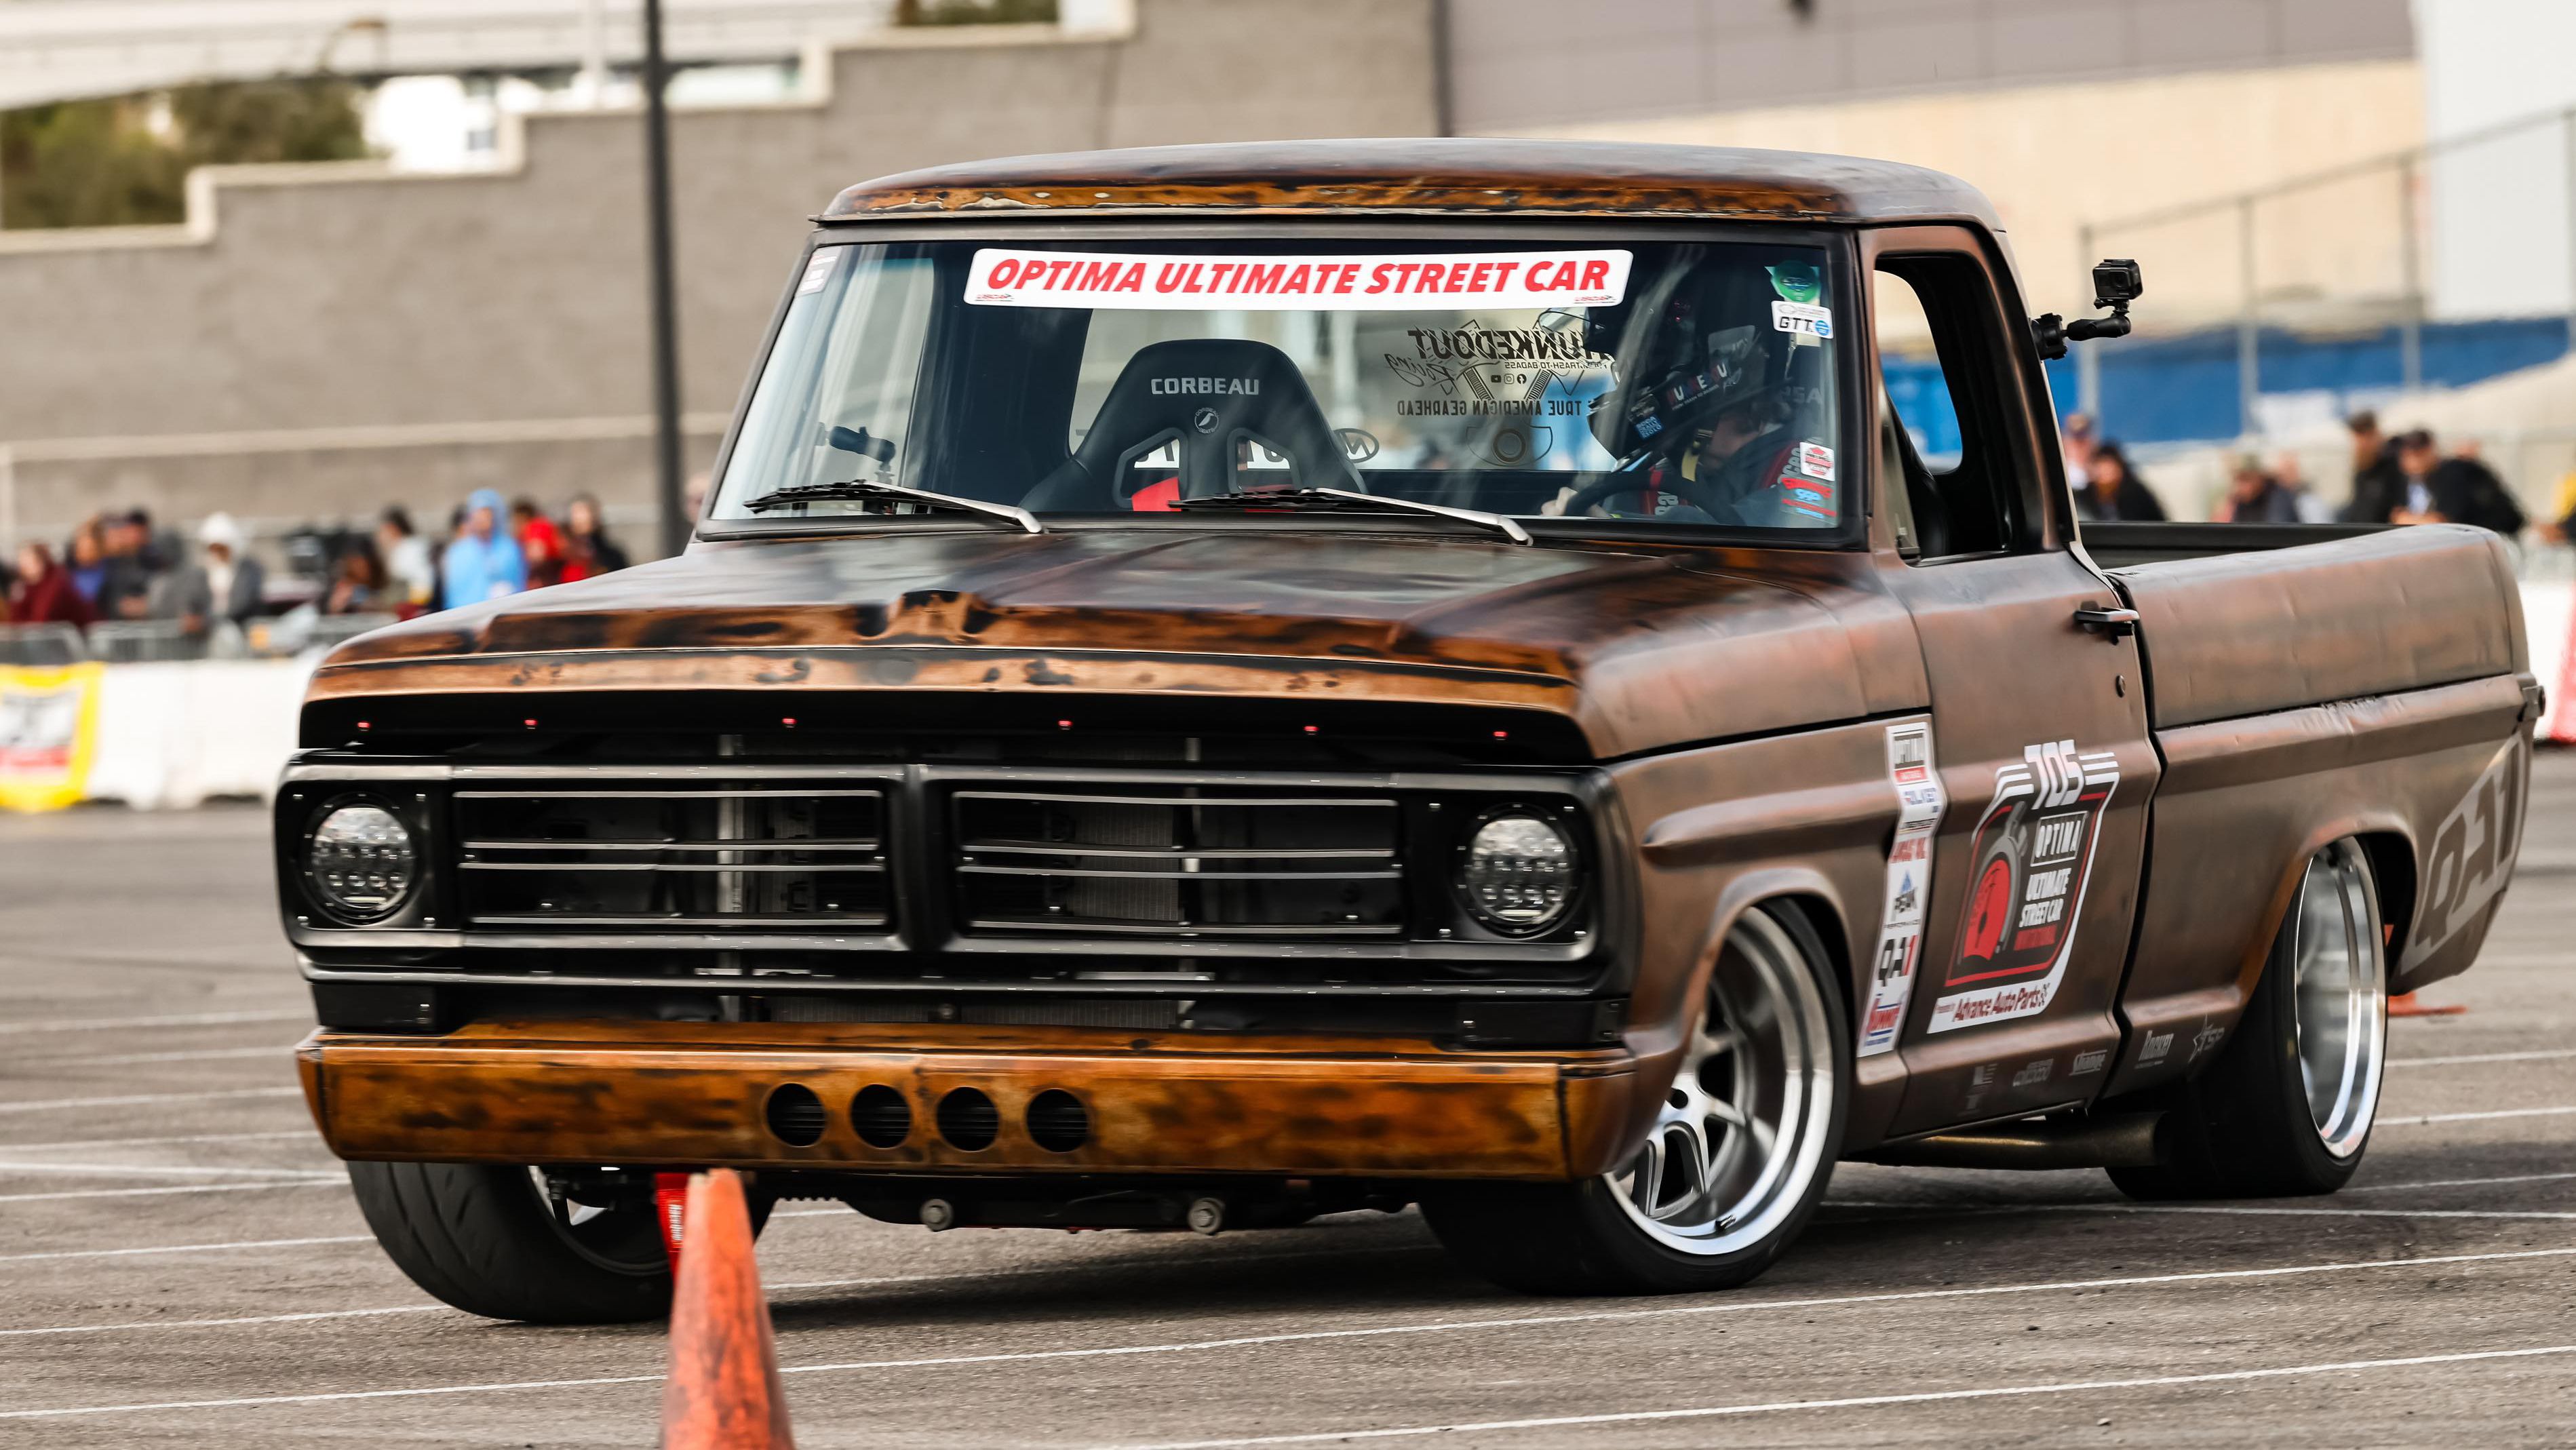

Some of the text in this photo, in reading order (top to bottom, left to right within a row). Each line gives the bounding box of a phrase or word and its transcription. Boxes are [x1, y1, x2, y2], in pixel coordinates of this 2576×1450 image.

[987, 258, 1609, 294] OPTIMA ULTIMATE STREET CAR
[1150, 377, 1260, 396] CORBEAU
[2023, 739, 2085, 810] 705
[2034, 819, 2082, 859] OPTIMA
[2025, 867, 2072, 902] ULTIMATE
[2018, 897, 2065, 928] STREET CAR
[1877, 935, 1919, 987] QA1
[1951, 997, 1993, 1023] Advance
[1991, 989, 2016, 1015] Auto
[2014, 985, 2042, 1012] Parts
